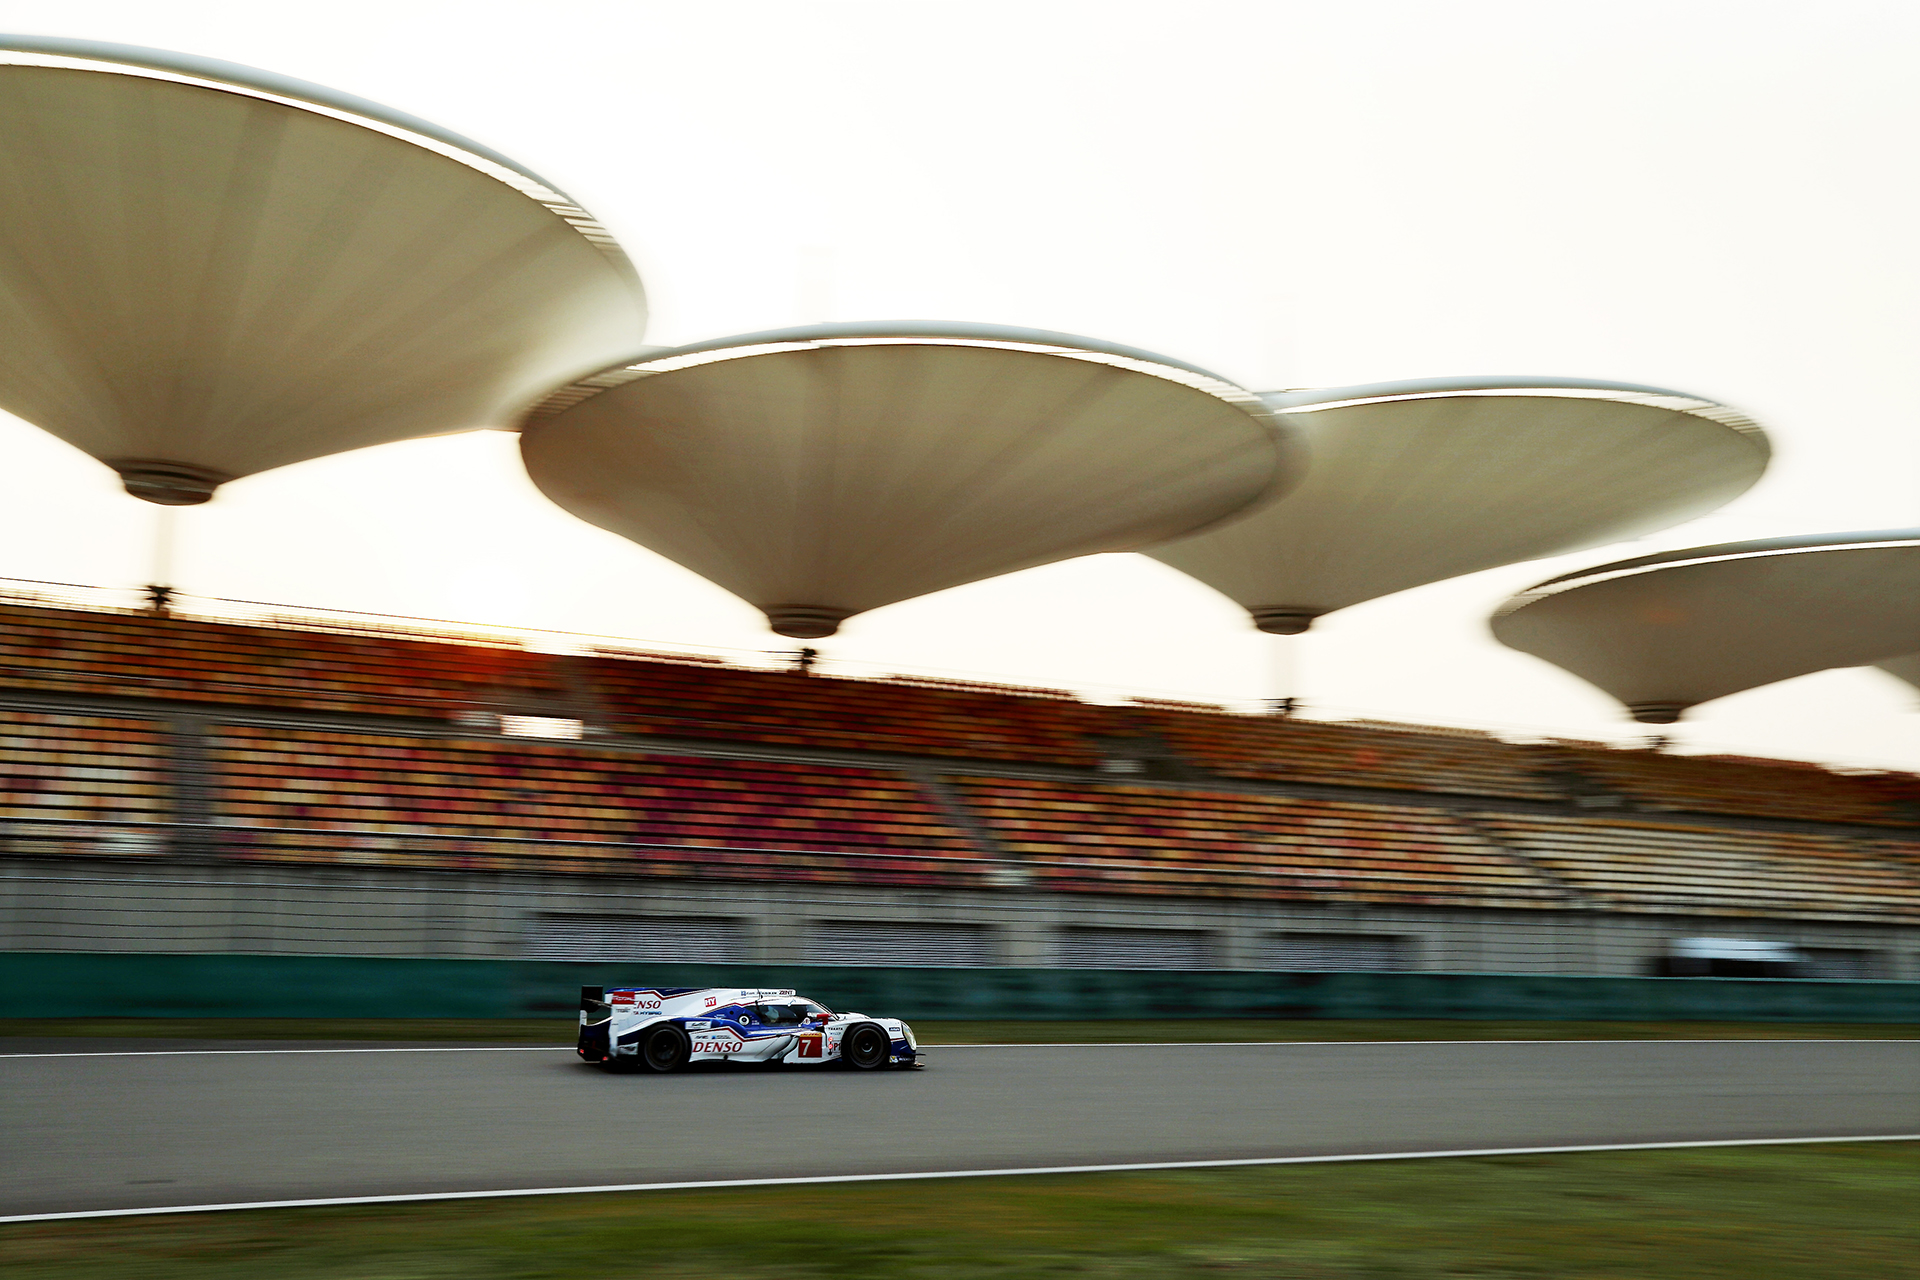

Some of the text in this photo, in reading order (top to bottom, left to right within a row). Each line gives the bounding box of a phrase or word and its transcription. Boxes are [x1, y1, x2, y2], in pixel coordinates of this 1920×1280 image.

[633, 1000, 662, 1009] ENSO
[705, 998, 715, 1006] HY
[692, 1041, 743, 1053] DENSO
[801, 1040, 811, 1056] 7
